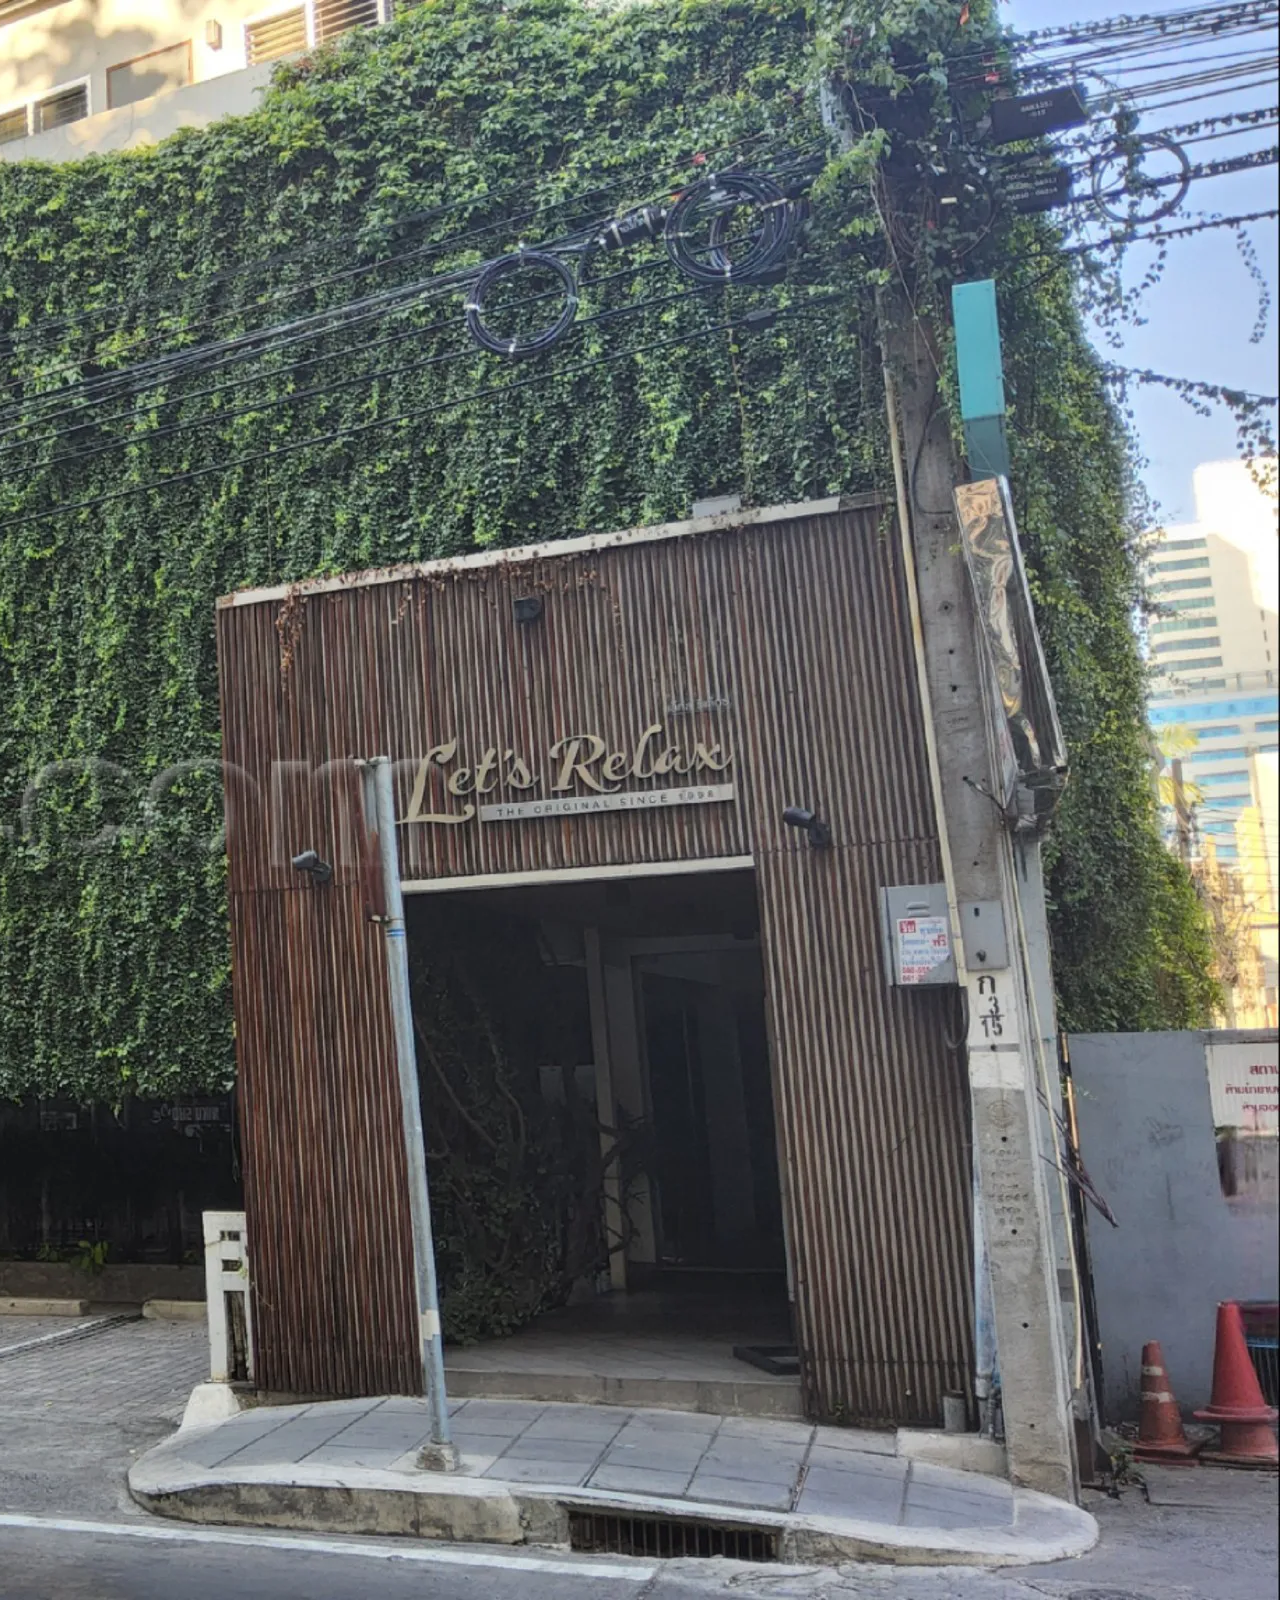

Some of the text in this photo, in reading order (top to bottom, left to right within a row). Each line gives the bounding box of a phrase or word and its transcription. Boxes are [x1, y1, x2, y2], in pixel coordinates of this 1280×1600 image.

[395, 724, 734, 824] Let's Relax
[496, 808, 524, 817] THE
[533, 800, 611, 814] ORIGINAL
[619, 793, 668, 806] SINCE
